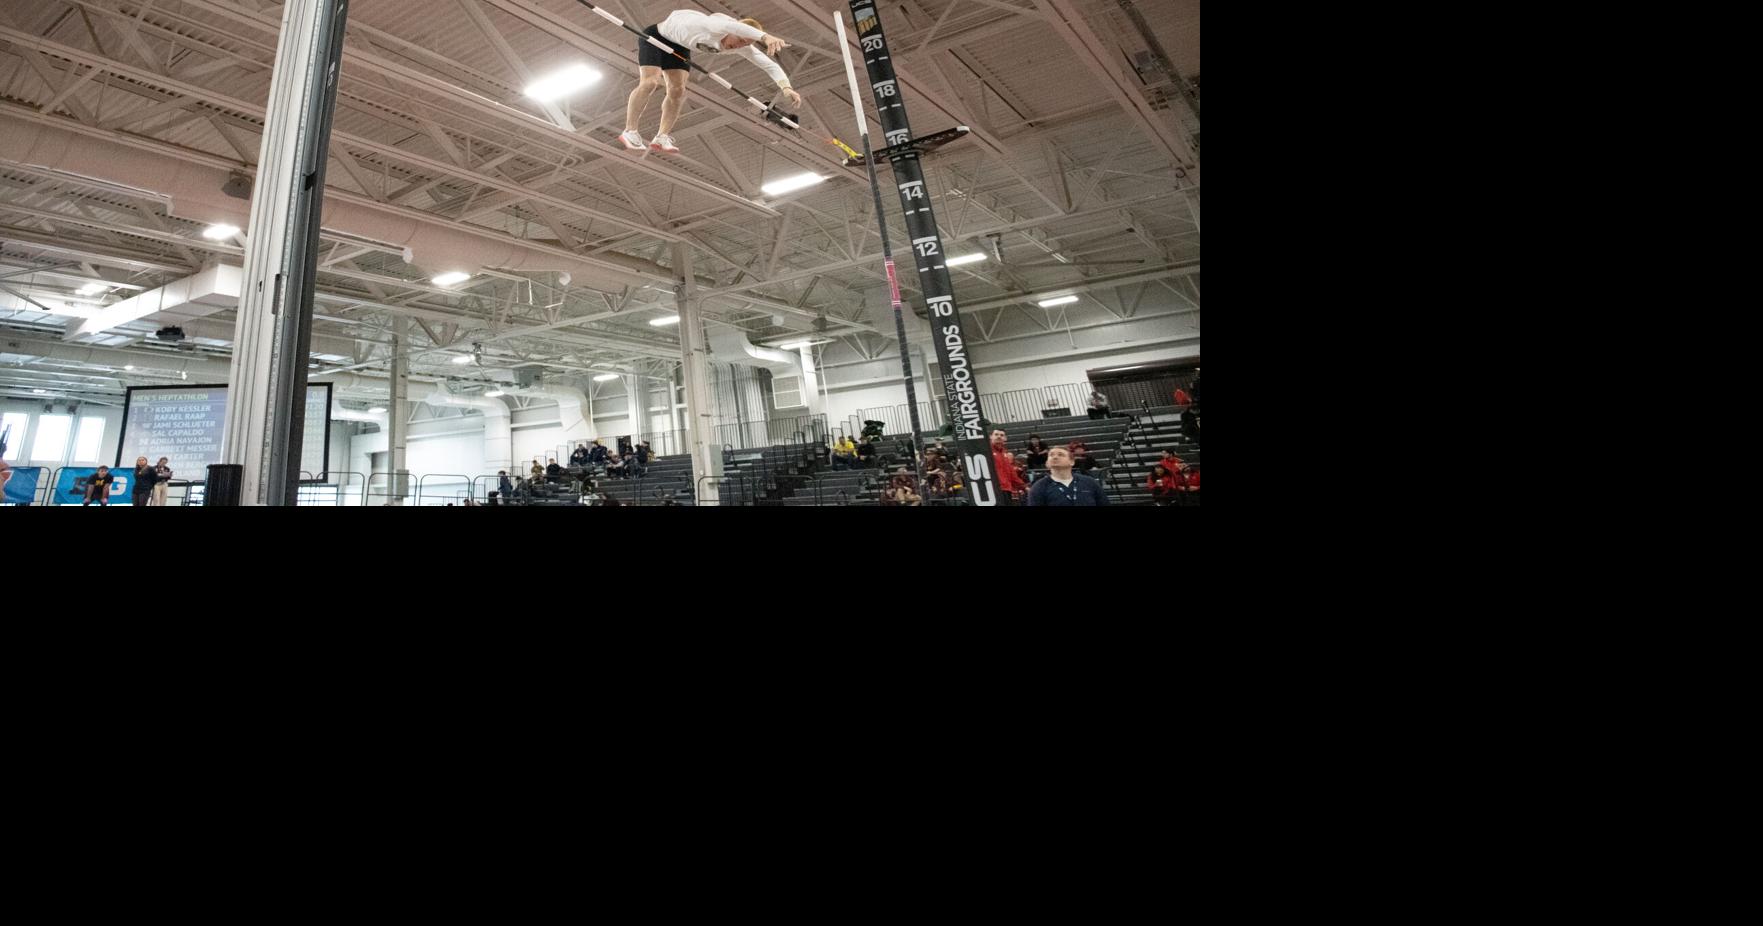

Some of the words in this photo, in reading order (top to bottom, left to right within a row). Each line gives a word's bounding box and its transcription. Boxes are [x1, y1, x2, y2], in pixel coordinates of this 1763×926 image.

[863, 39, 883, 52] 20
[875, 84, 896, 98] 18
[888, 133, 909, 146] 16
[902, 185, 924, 201] 14
[916, 242, 939, 257] 12
[930, 301, 953, 317] 10
[942, 325, 984, 440] FAIRGROUNDS
[944, 374, 959, 401] STATE
[158, 393, 209, 401] HEPTATHLON
[950, 402, 967, 441] INDIANA
